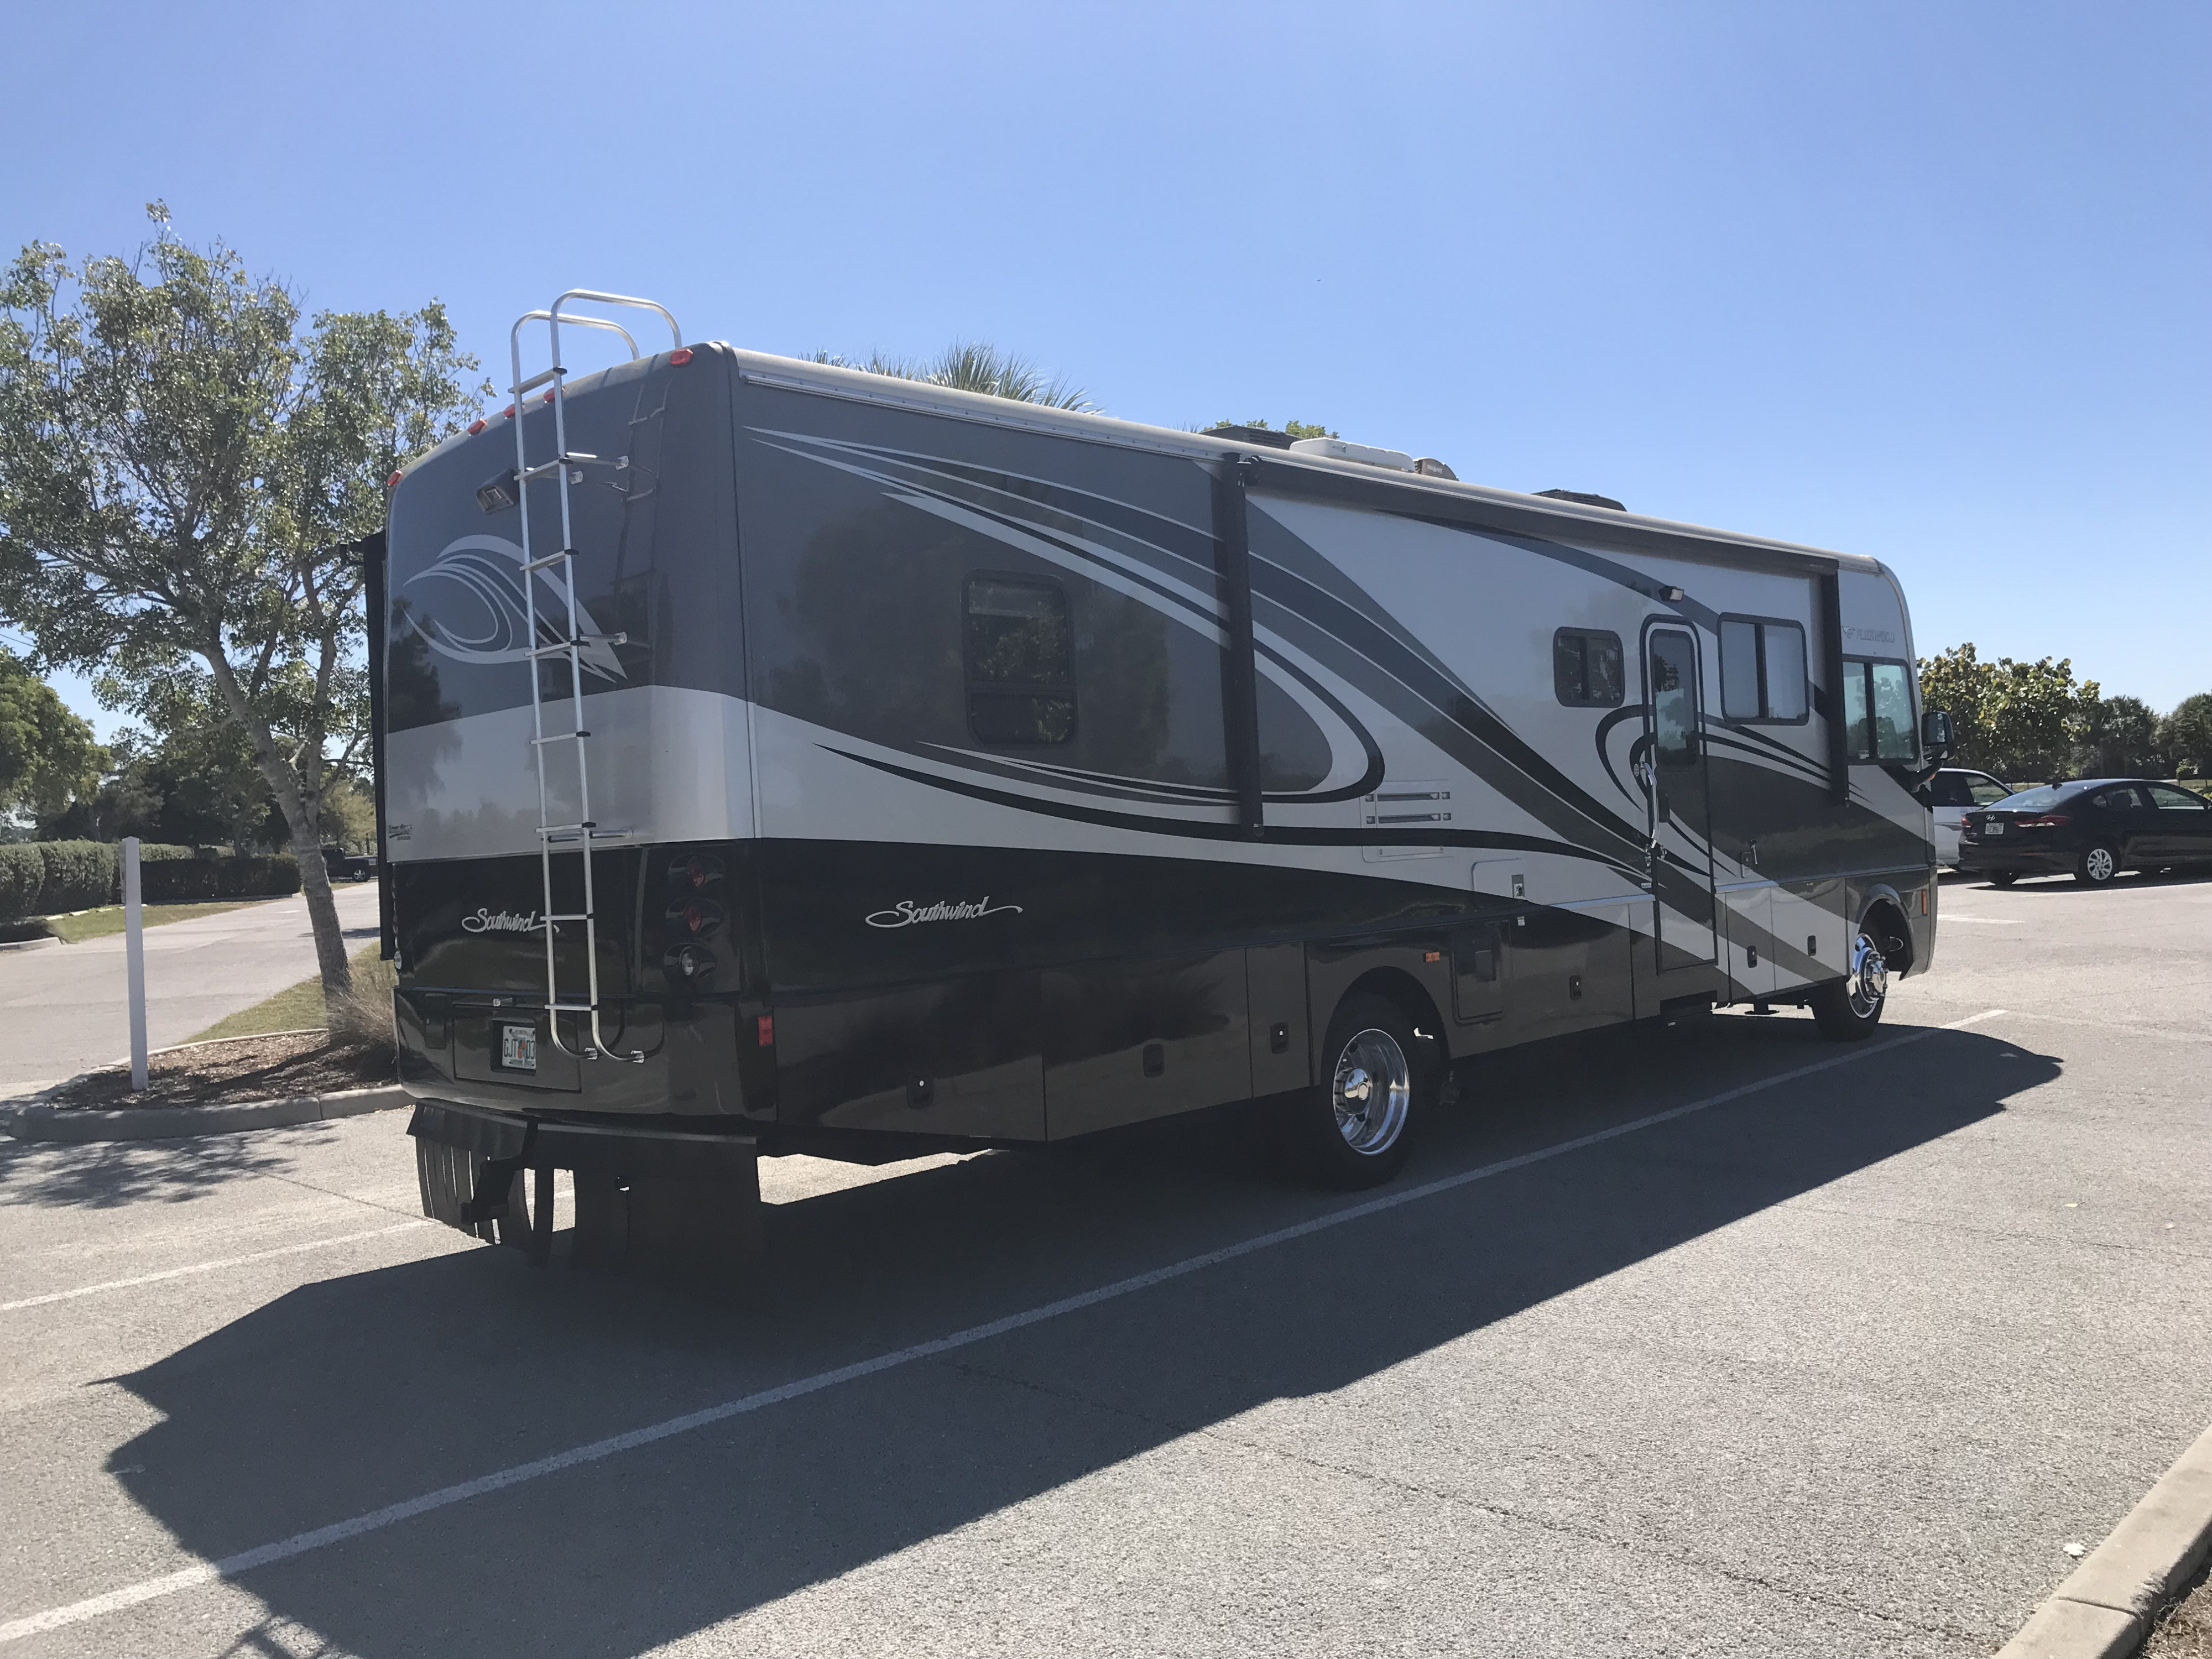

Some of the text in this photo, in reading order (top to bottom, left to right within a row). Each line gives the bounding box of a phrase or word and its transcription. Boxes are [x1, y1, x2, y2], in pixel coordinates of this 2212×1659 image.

[461, 907, 560, 933] Southwind
[865, 895, 1023, 928] Southwind
[504, 1038, 518, 1058] GJT
